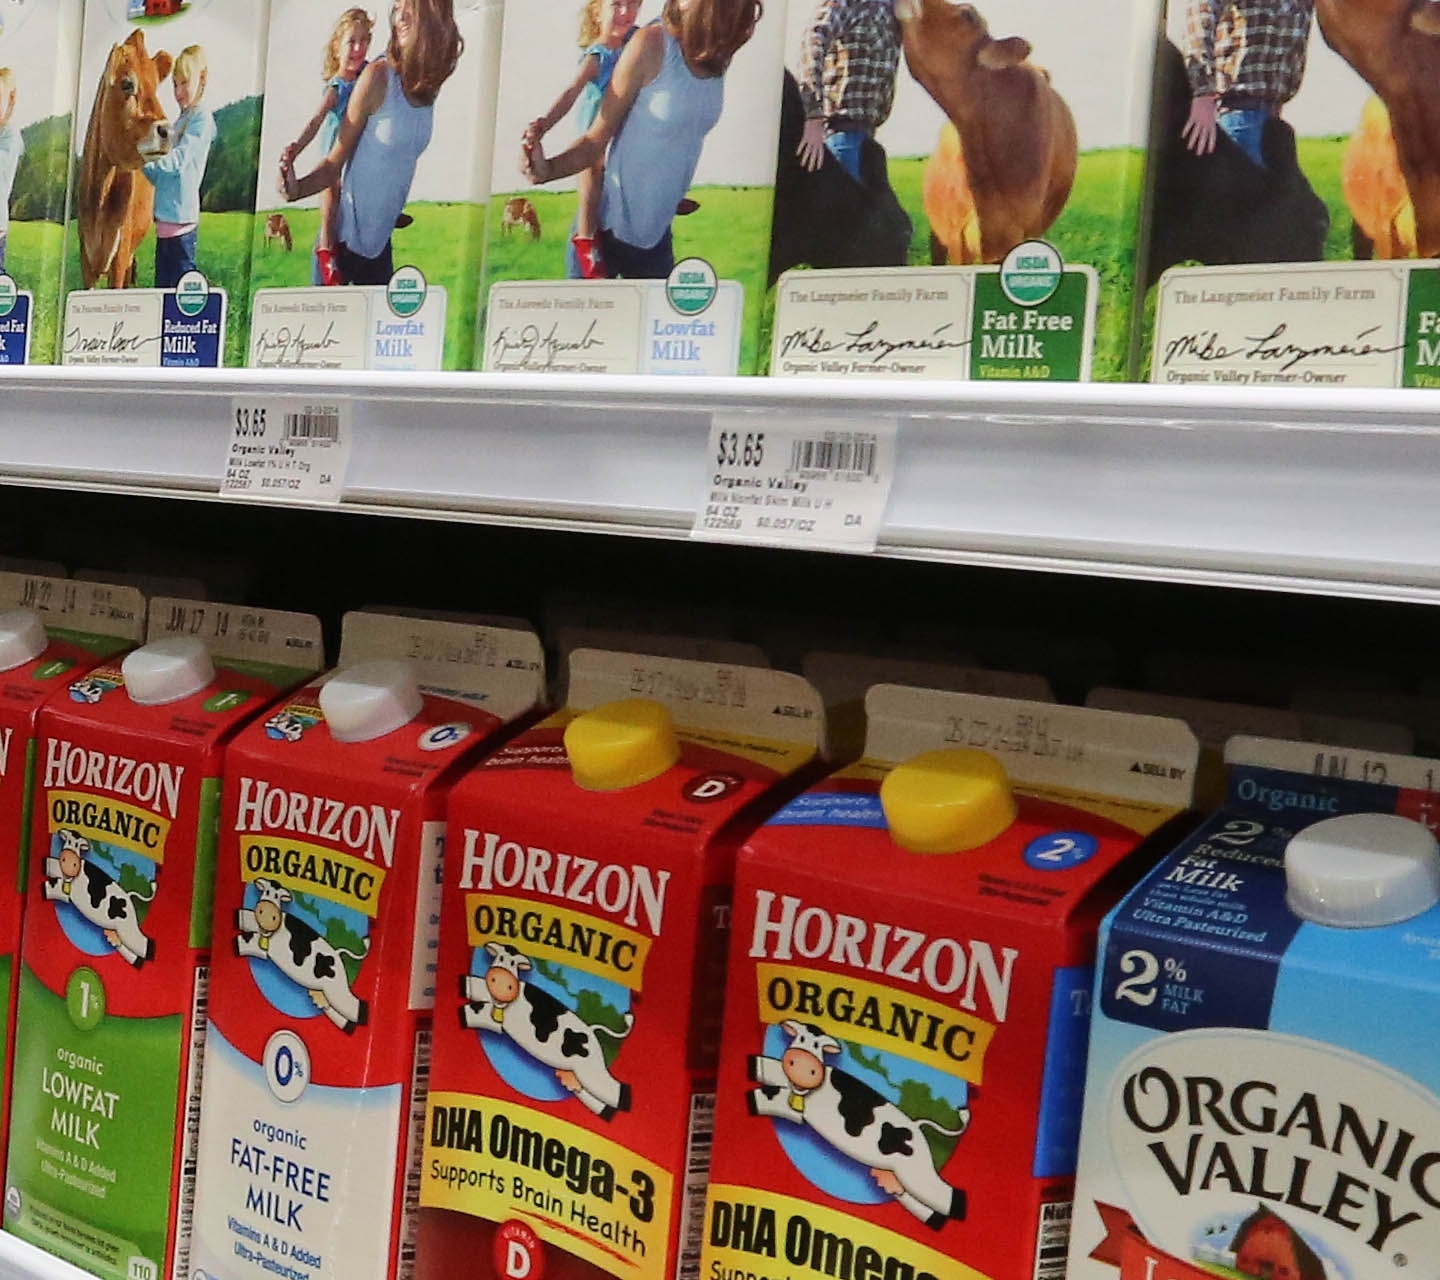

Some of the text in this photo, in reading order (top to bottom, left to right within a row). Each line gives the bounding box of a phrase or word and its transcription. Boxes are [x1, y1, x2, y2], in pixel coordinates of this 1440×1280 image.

[1175, 290, 1199, 305] The
[1279, 286, 1331, 305] Family
[1334, 286, 1376, 301] Farm
[652, 341, 701, 361] Milk
[653, 320, 715, 338] Lowfat
[236, 408, 266, 437] $3.65
[717, 430, 764, 468] $3.65
[714, 474, 808, 493] Organic Valley
[44, 736, 185, 822] HORIZON
[50, 797, 161, 850] ORGANIC
[233, 777, 400, 869] HORIZON
[244, 842, 377, 904] ORGANIC
[460, 829, 672, 937] HORIZON
[472, 902, 639, 974] ORGANIC
[748, 889, 1018, 1023] HORIZON
[766, 975, 979, 1064] ORGANIC
[42, 1066, 120, 1121] LOWFAT
[51, 1107, 100, 1151] MILK
[230, 1137, 331, 1204] FAT-FREE
[431, 1105, 656, 1223] DHA Omega-3
[1147, 1131, 1423, 1252] VALLEY
[245, 1184, 304, 1233] MILK
[430, 1159, 647, 1258] Supports Brain Health
